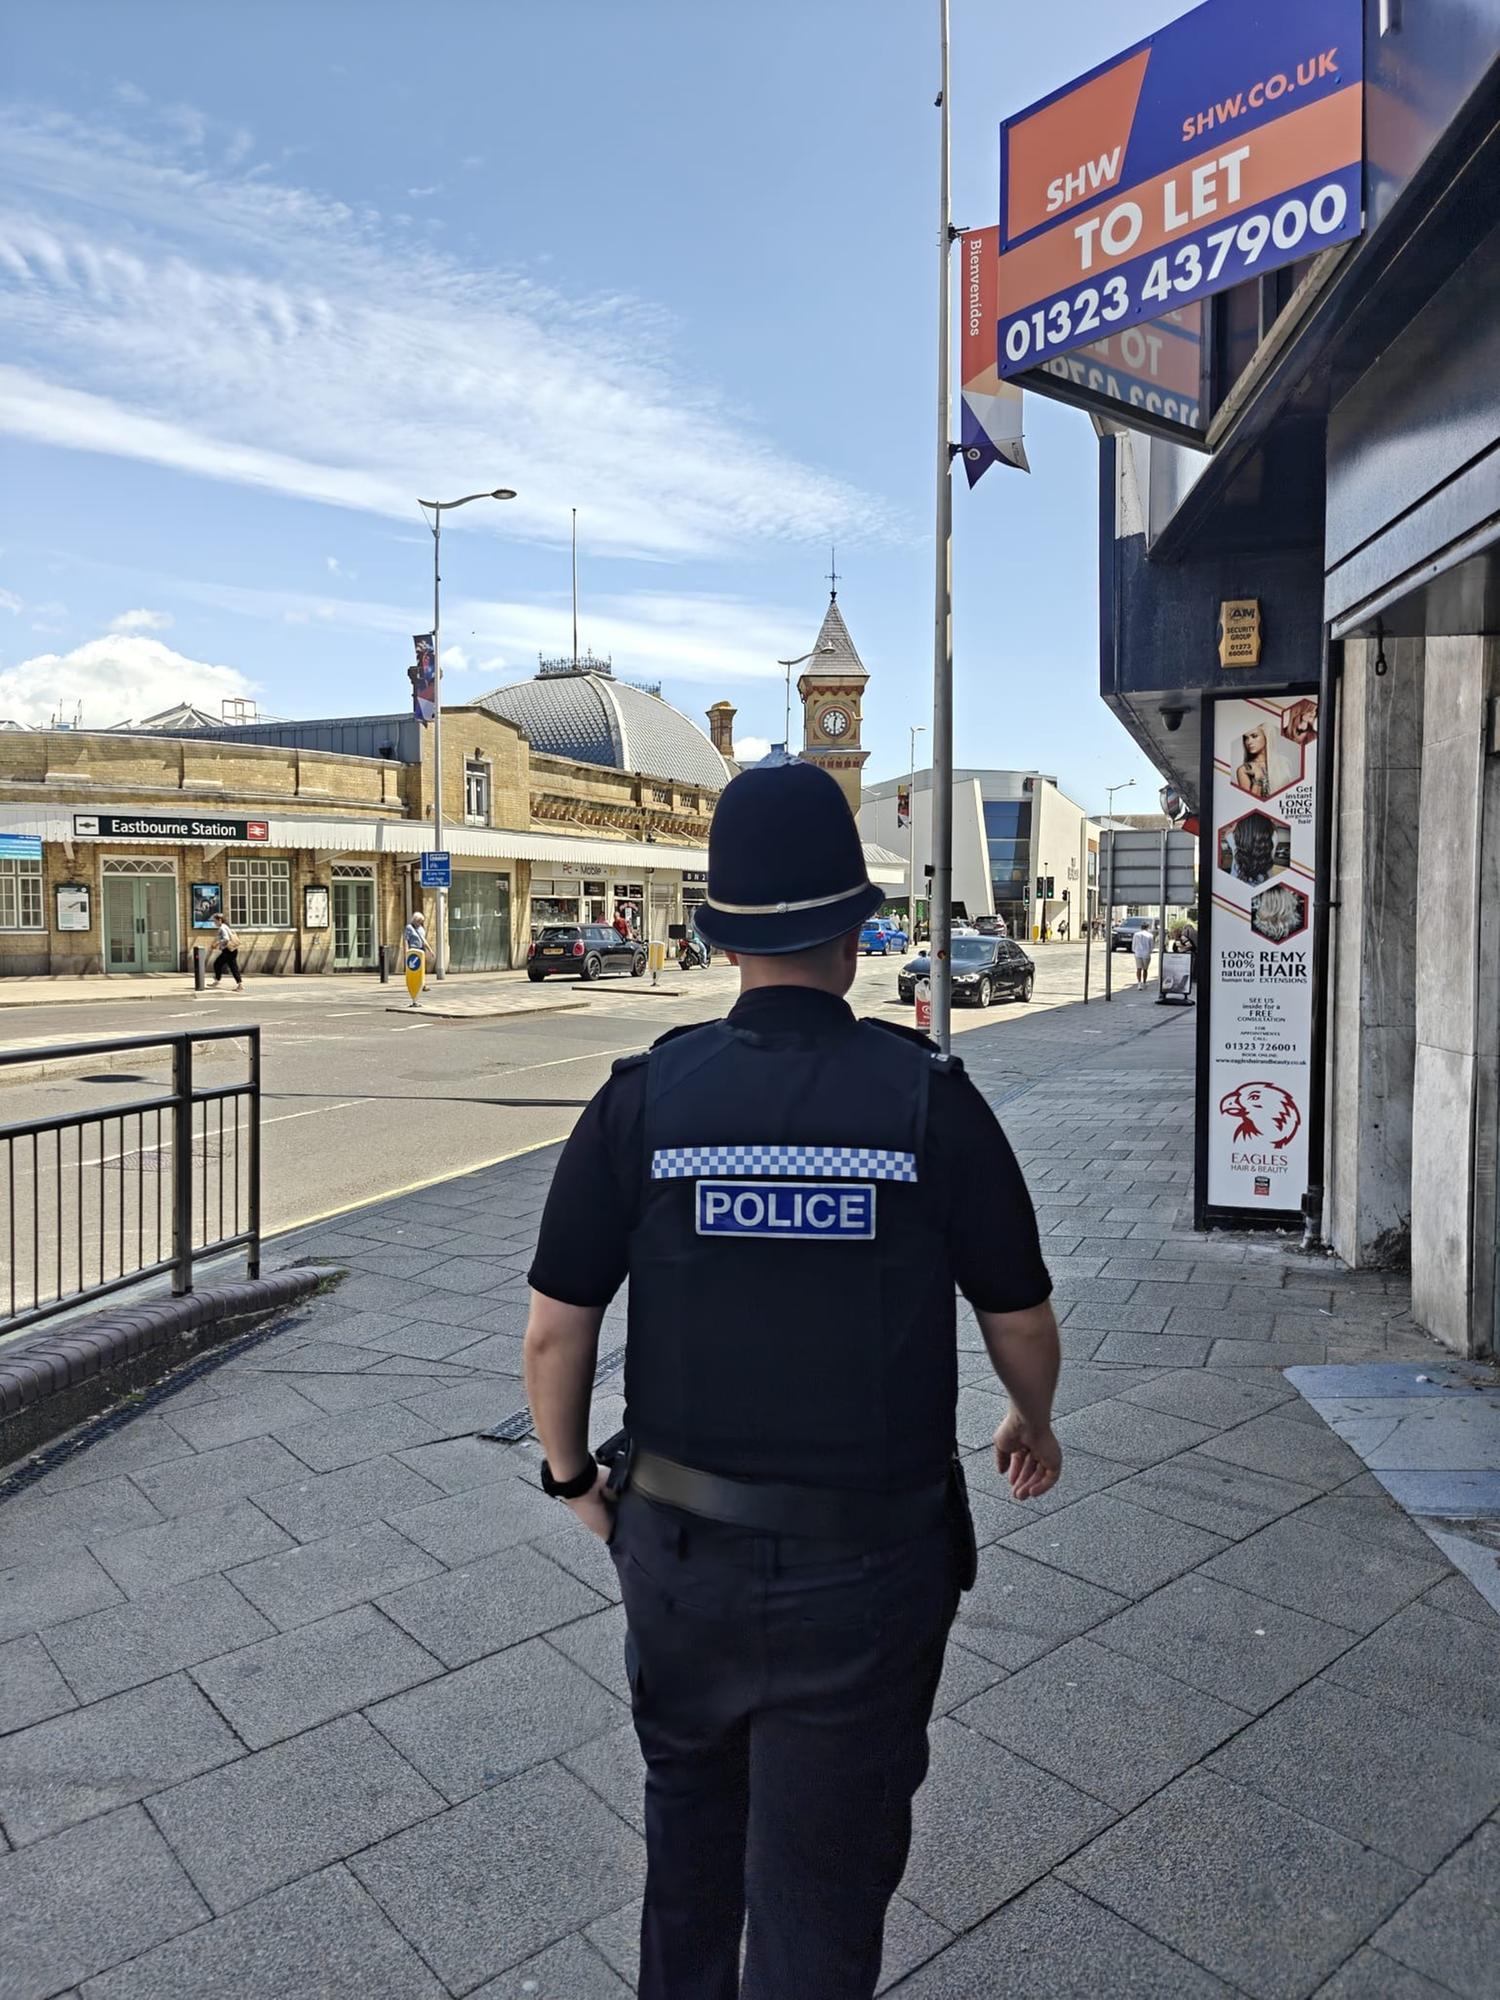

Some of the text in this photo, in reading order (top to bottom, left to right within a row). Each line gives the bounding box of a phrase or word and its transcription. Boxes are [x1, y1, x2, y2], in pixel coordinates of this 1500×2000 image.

[1182, 47, 1338, 142] SHW.CO.UK
[1046, 146, 1121, 212] SHW
[1074, 145, 1250, 270] TO LET
[1005, 184, 1347, 362] 01323 437900
[969, 238, 982, 337] Bienvenidos
[1226, 626, 1255, 634] SECURITY
[1230, 643, 1252, 651] 01273
[1296, 785, 1313, 793] Get
[1279, 800, 1313, 808] LONG
[1280, 807, 1313, 815] THICK
[111, 819, 237, 837] Eastbourne Station
[1221, 951, 1255, 960] LONG
[1260, 951, 1306, 963] REMY
[1221, 959, 1256, 969] 100%
[1221, 969, 1256, 978] natural
[1260, 963, 1307, 977] HAIR
[1225, 1042, 1297, 1052] 01323 726001
[1231, 1153, 1288, 1167] EAGLES
[1258, 1165, 1289, 1174] BEAUTY
[706, 1192, 866, 1229] POLICE
